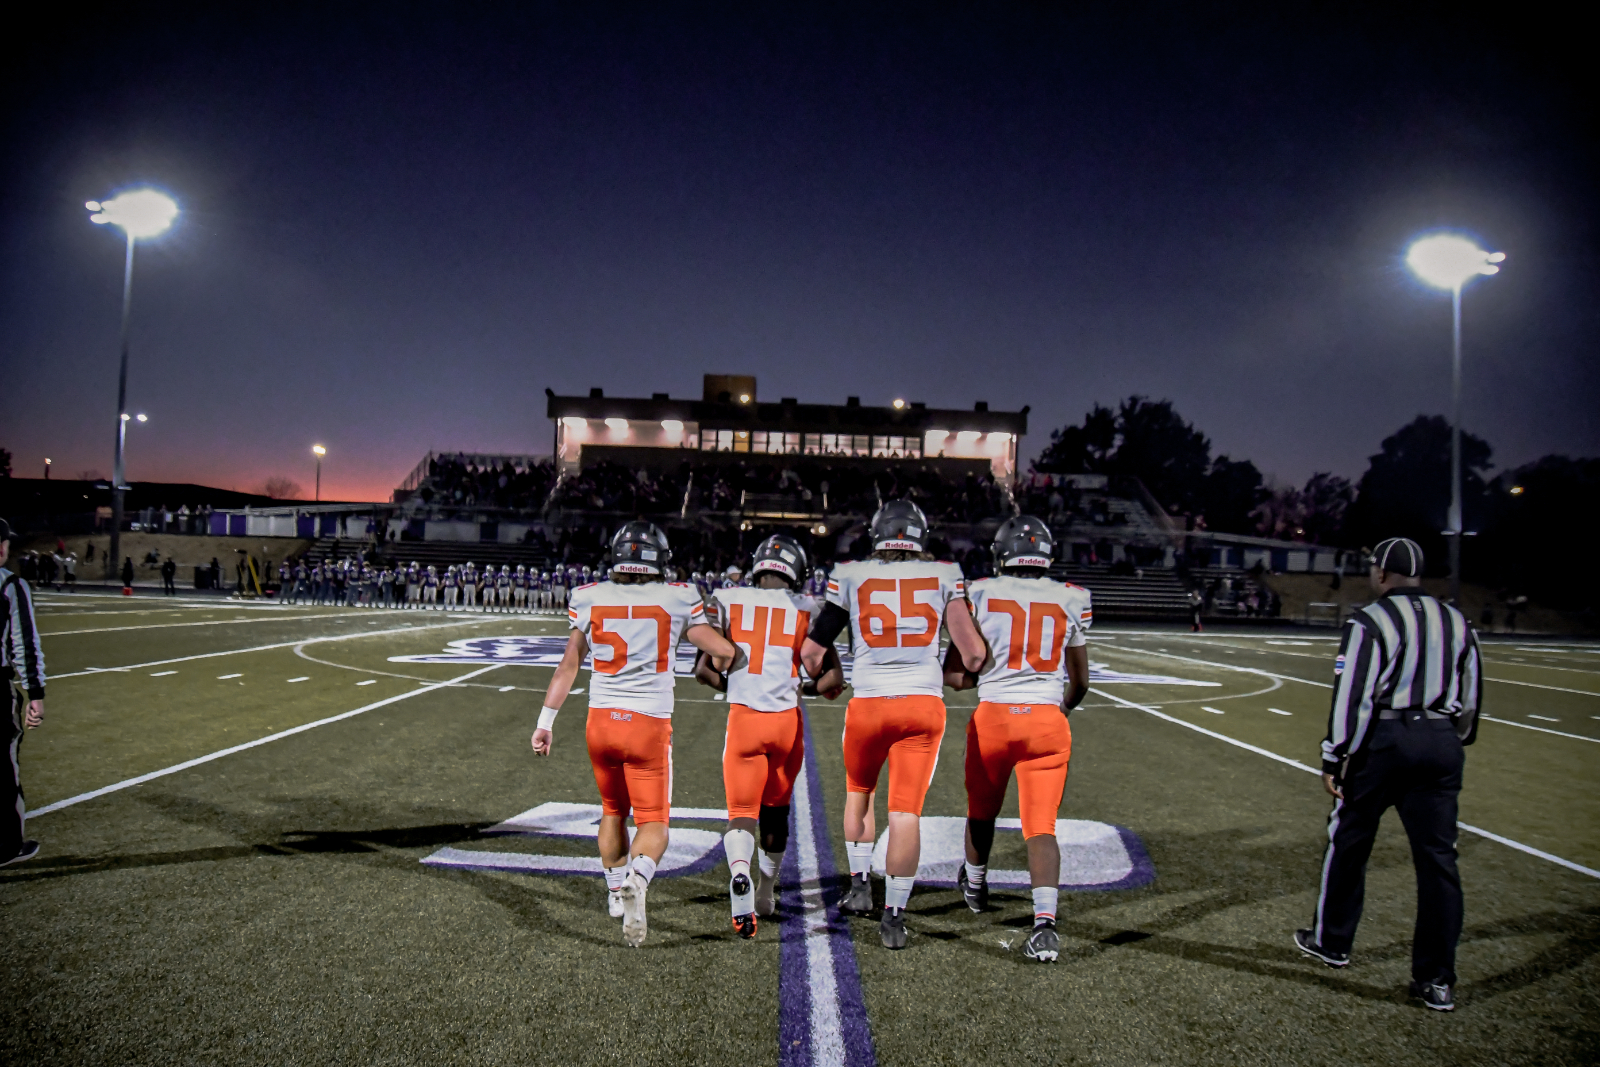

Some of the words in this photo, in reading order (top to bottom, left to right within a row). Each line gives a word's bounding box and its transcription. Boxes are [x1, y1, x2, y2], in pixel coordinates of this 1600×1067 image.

[619, 565, 649, 573] Riddell
[760, 561, 788, 573] Rddell
[885, 542, 914, 550] Riddell
[591, 605, 671, 675] 57
[730, 603, 811, 678] 44
[857, 577, 939, 648] 65
[987, 598, 1067, 672] 70
